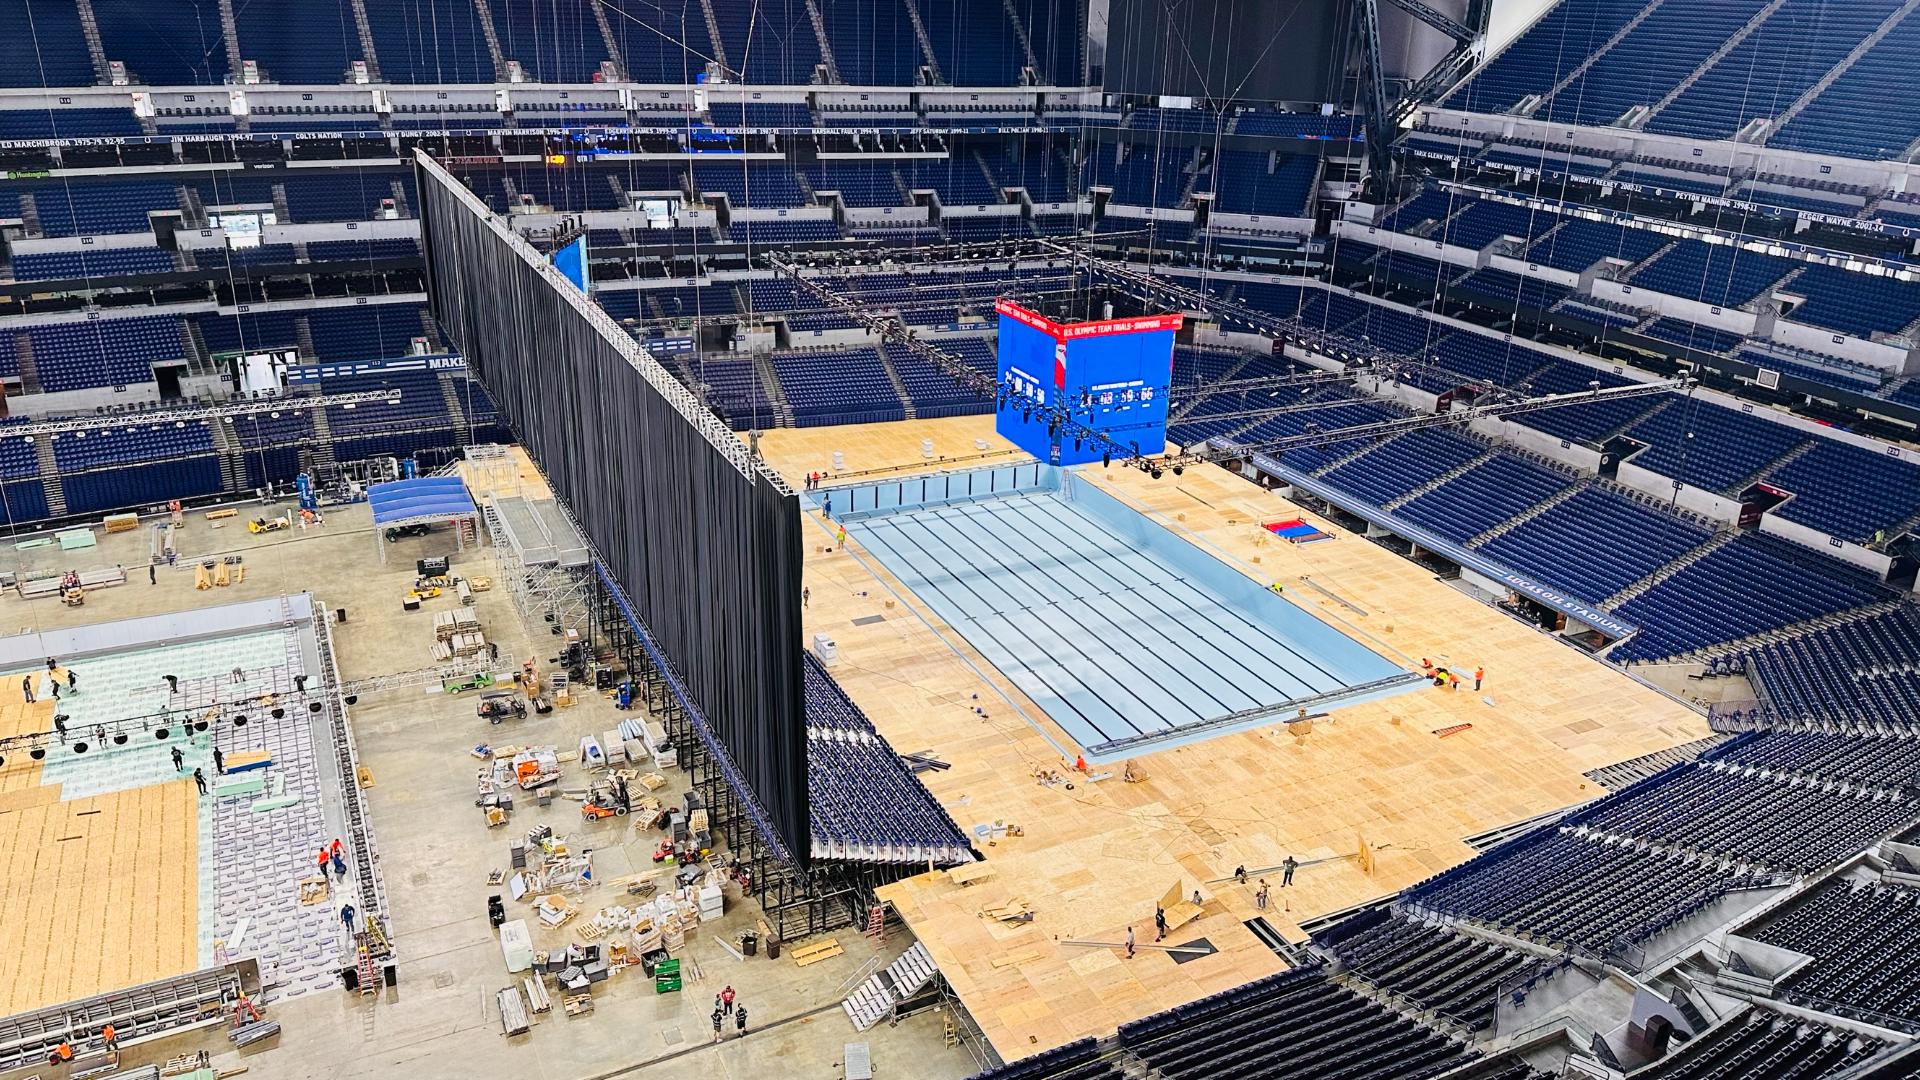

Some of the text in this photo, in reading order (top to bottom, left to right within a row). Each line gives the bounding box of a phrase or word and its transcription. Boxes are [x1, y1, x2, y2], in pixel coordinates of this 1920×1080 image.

[185, 134, 224, 142] HARBAUGH
[1570, 175, 1591, 184] DWIGHT
[1592, 177, 1618, 188] FREENEY
[1675, 191, 1700, 202] PEYTON
[1701, 195, 1730, 207] MANNING
[1797, 211, 1883, 232] REGGIE WAYNE 2001-14
[1074, 326, 1097, 335] OLYMPIC
[1098, 324, 1112, 333] TEAM
[429, 356, 466, 368] MAKE
[1505, 575, 1623, 632] LUCAS OIL STADIUM
